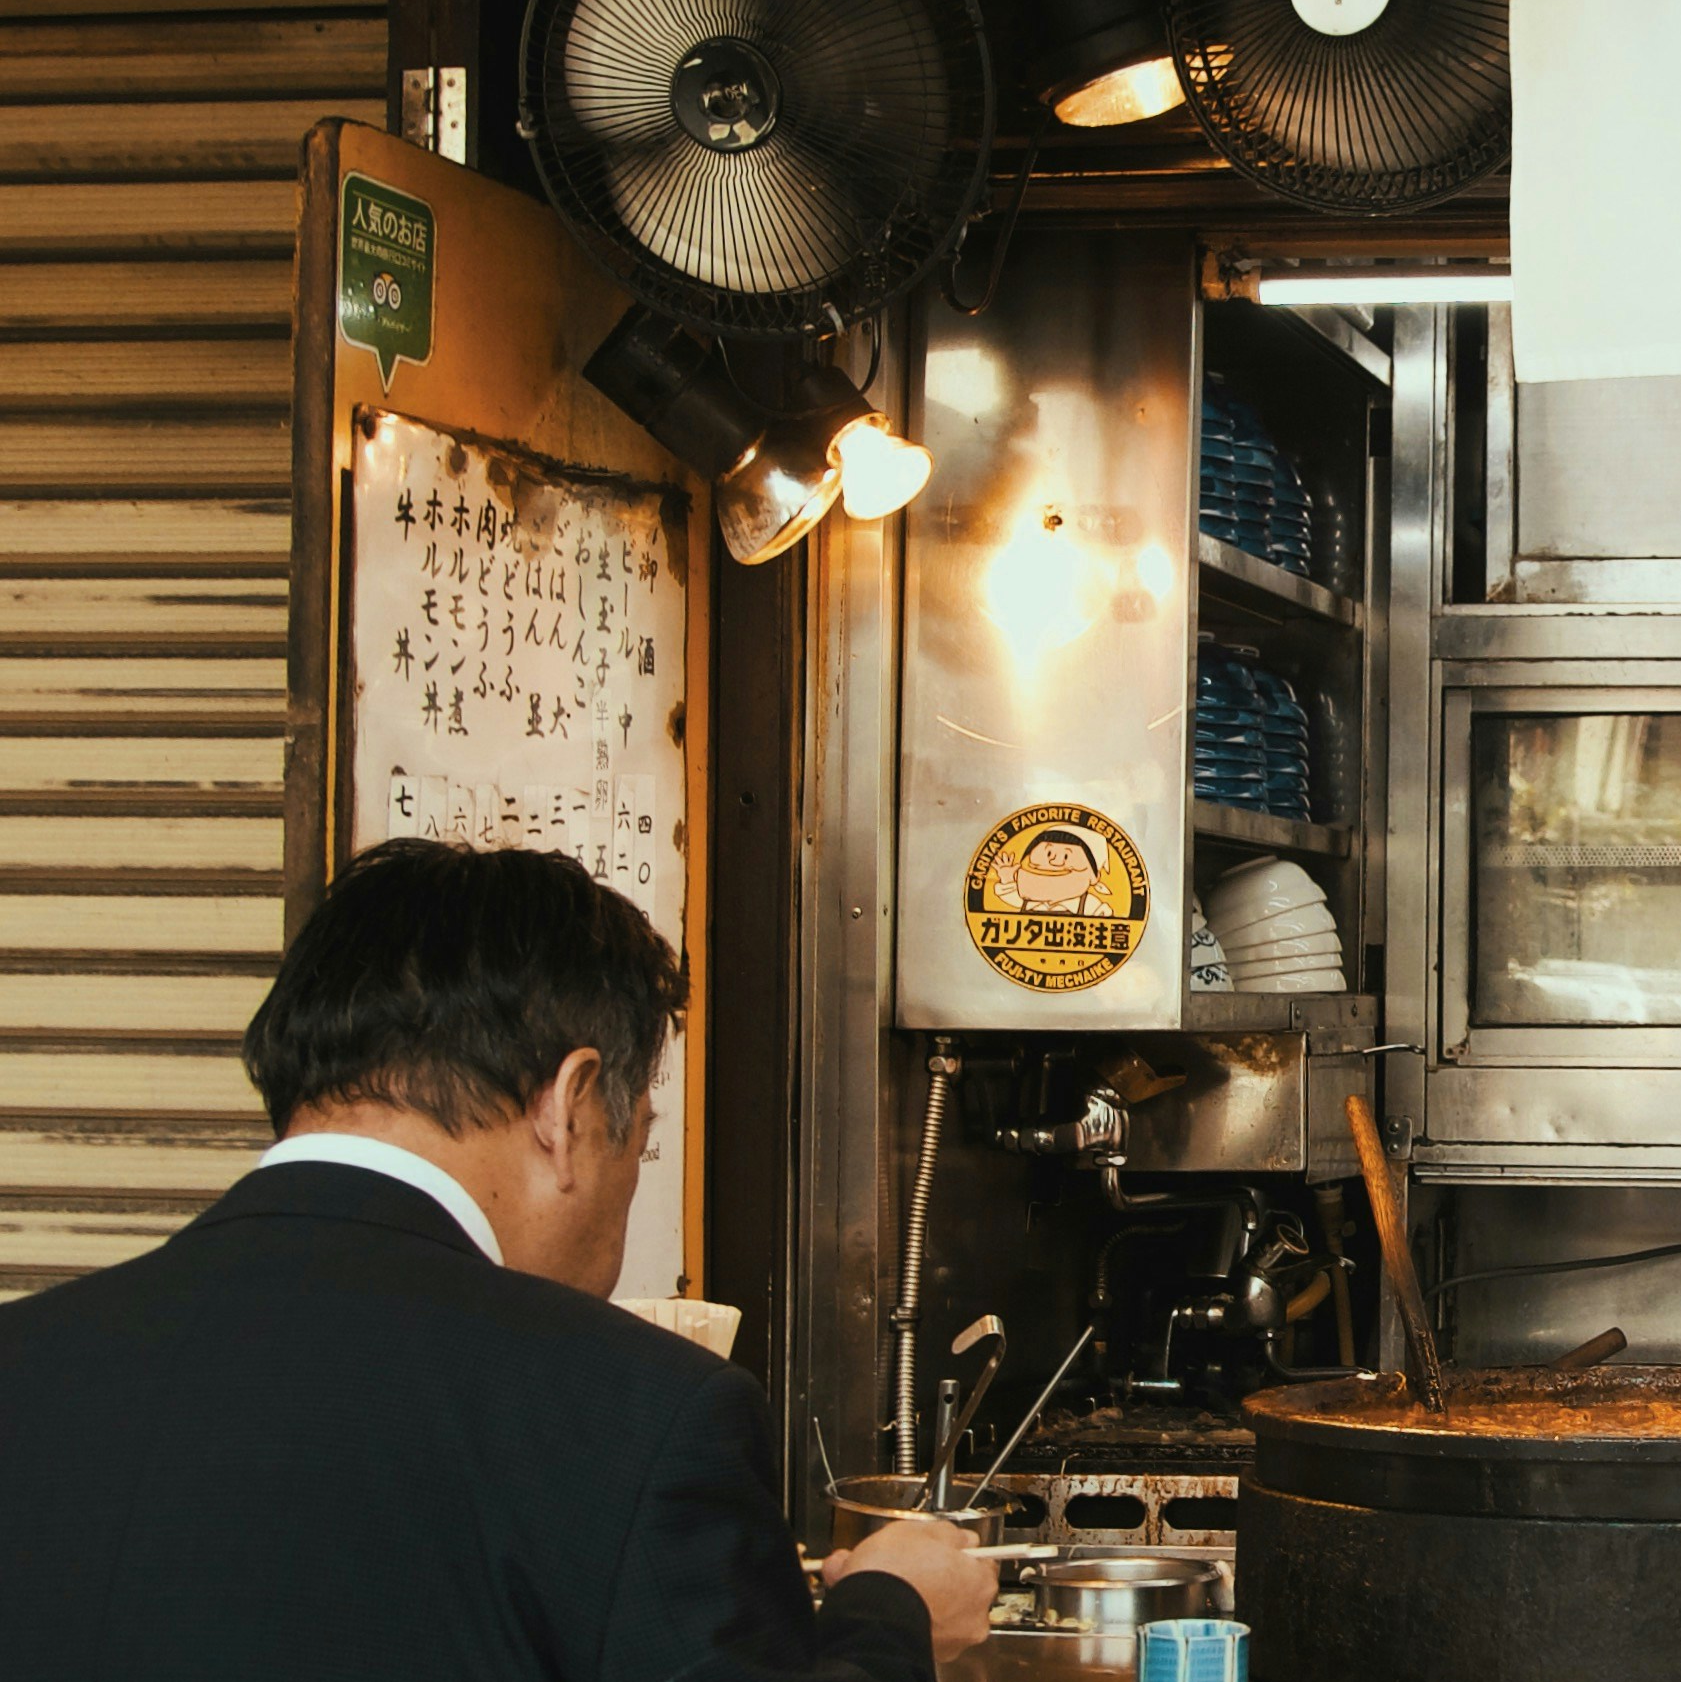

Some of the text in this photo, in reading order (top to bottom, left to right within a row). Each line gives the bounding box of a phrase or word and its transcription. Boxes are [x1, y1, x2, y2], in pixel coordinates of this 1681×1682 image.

[352, 197, 427, 254] 人気のお店
[473, 498, 497, 699] 肉どうふ
[971, 807, 1146, 897] GARITA'S FAVORITE RESTAURANT
[980, 917, 1132, 951] ガリタ出没注意
